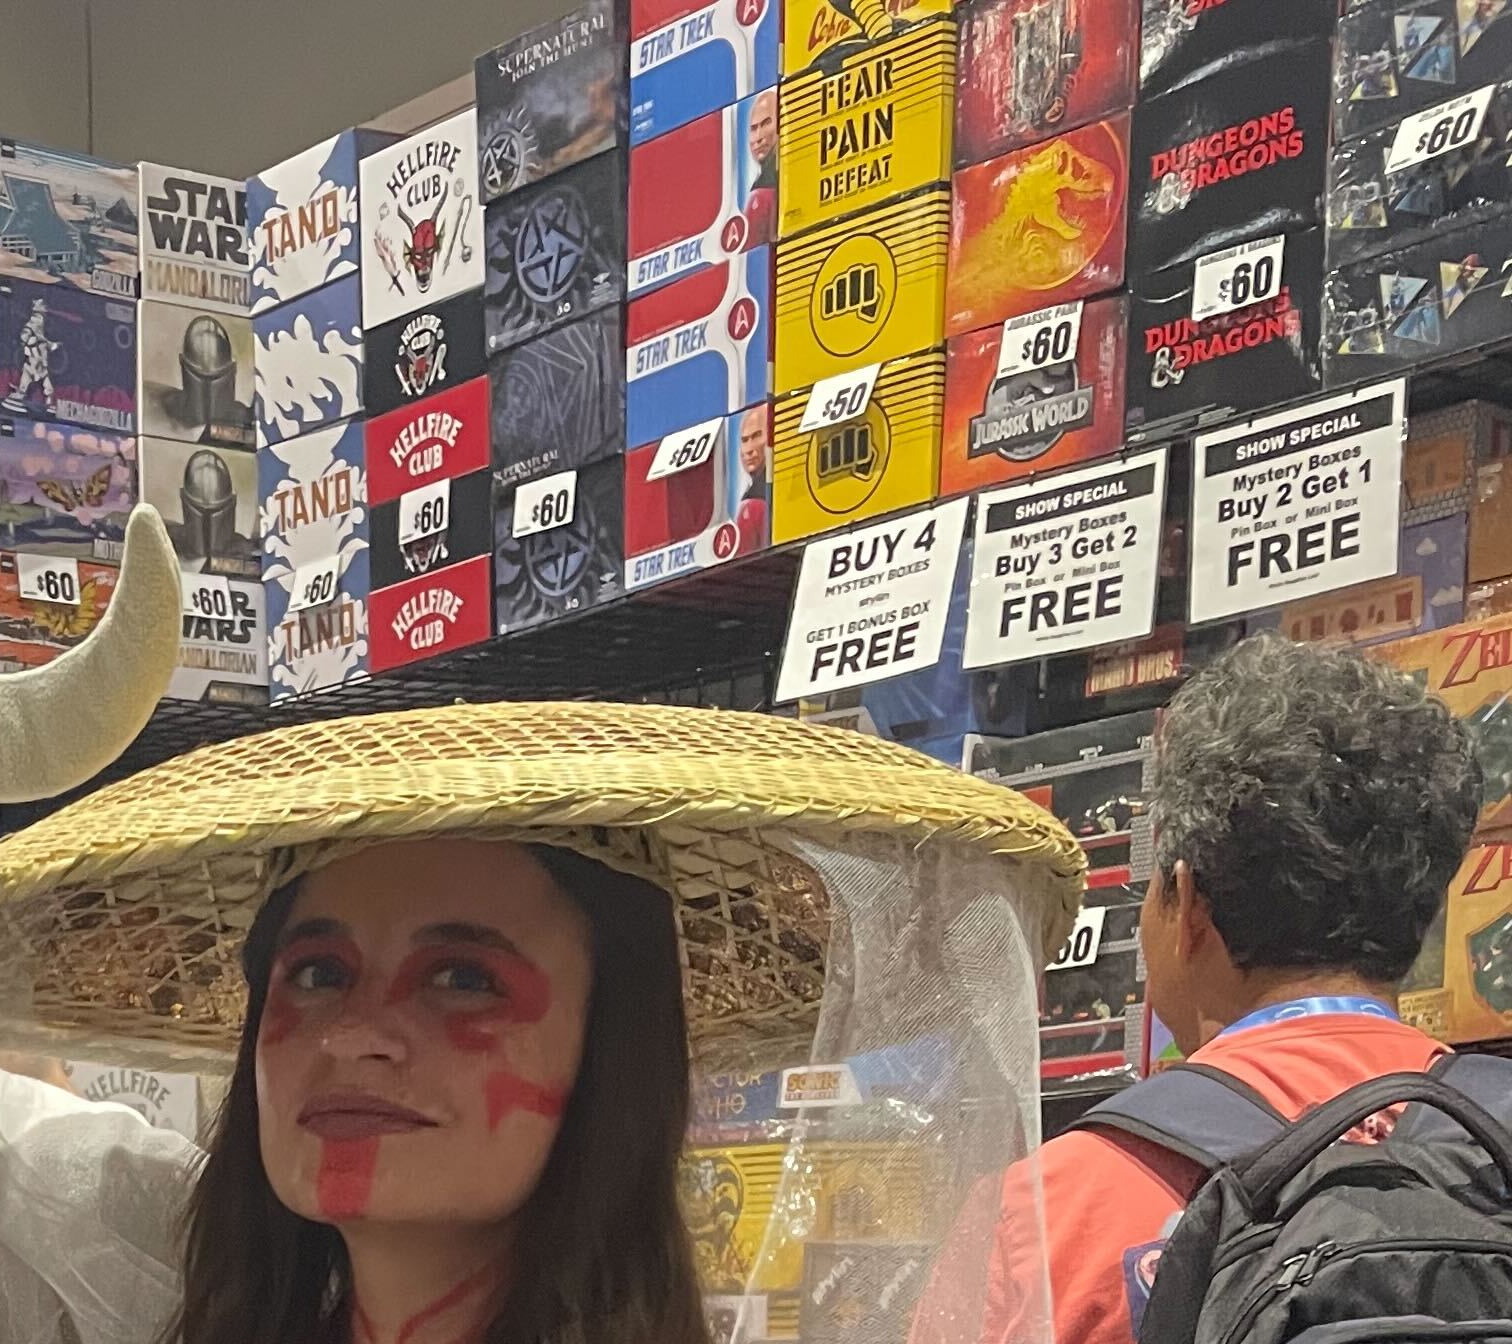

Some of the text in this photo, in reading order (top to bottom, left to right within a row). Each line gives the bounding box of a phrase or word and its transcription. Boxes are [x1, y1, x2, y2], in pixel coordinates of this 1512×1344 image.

[639, 8, 716, 69] STAR TREK
[821, 58, 893, 116] FEAR
[820, 103, 893, 166] PAIN
[1152, 107, 1294, 180] DUNGEONS
[1415, 107, 1477, 154] $60
[387, 141, 461, 198] HELLFIRE
[820, 153, 892, 201] DEFEAT
[1180, 131, 1304, 195] DRAGONS
[407, 174, 441, 207] CLUB
[148, 212, 248, 265] WAR
[638, 238, 704, 284] STAR TREK
[1218, 256, 1273, 305] $60
[636, 320, 708, 375] STAR TREK
[1021, 321, 1072, 365] $60
[822, 382, 868, 421] $50
[972, 397, 1089, 450] JURASSIC WORLD
[389, 411, 463, 468] HELLFIRE
[409, 444, 443, 476] CLUB
[670, 432, 711, 468] $60
[1236, 412, 1361, 461] SHOW SPECIAL
[1217, 458, 1372, 523] Buy 2 Get 1
[1232, 444, 1362, 493] Mystery Boxes
[414, 497, 444, 533] $60
[532, 489, 568, 527] $60
[1015, 481, 1128, 520] SHOW SPECIAL
[828, 518, 937, 579] BUY 4
[1010, 511, 1127, 550] Mystery Boxes
[1227, 512, 1361, 588] FREE
[1253, 519, 1278, 533] Box
[634, 543, 697, 582] STAR TREK
[995, 525, 1138, 577] Buy 3 Get 2
[37, 570, 74, 602] $60
[304, 571, 333, 604] $60
[825, 558, 931, 598] MYSTERY BOXES
[192, 588, 227, 617] $60
[392, 587, 463, 640] HELLFIRE
[806, 624, 838, 644] GET
[847, 610, 898, 634] BONUS
[900, 600, 931, 620] BOX
[999, 574, 1124, 638] FREE
[410, 620, 444, 650] CLUB
[810, 621, 920, 682] FREE
